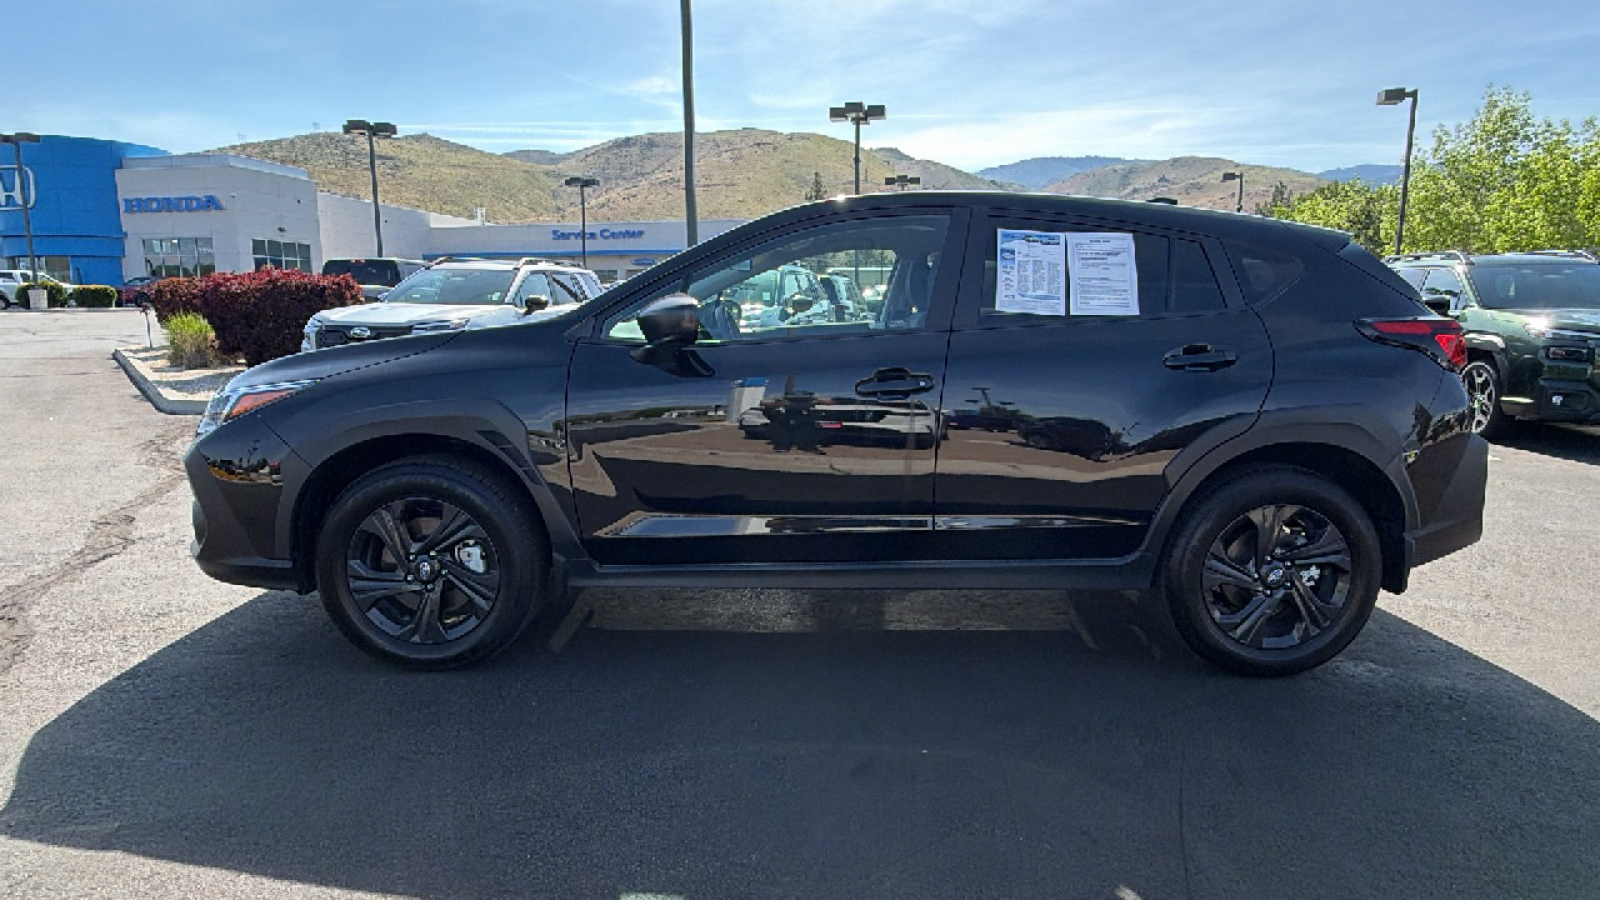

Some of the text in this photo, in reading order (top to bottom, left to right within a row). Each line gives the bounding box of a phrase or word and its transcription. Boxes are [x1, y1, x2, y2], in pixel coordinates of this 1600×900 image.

[123, 195, 224, 213] HONDA
[551, 228, 645, 241] Service Center
